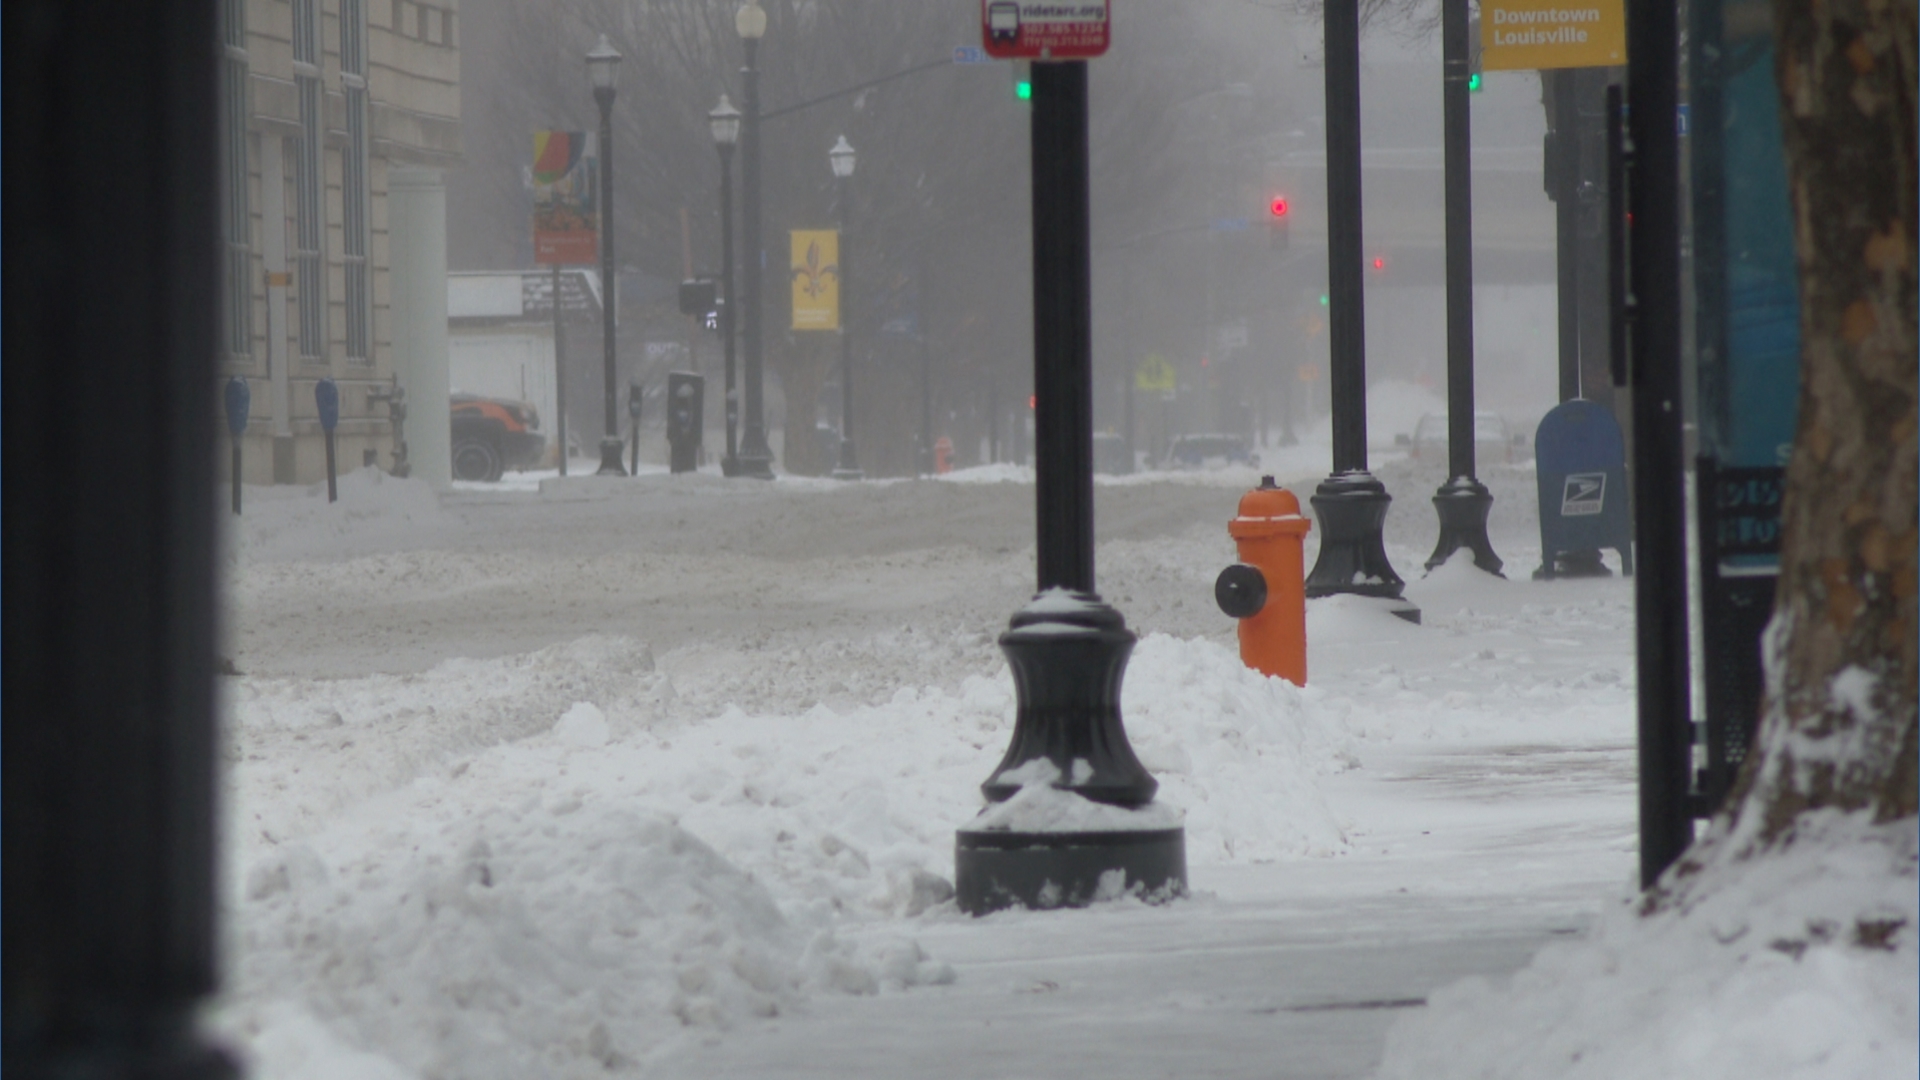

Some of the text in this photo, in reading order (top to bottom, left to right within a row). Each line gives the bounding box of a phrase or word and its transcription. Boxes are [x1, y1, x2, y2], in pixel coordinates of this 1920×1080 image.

[1023, 5, 1104, 19] ridetarc.org
[1493, 8, 1600, 24] Downtown
[1494, 27, 1588, 45] Louisville
